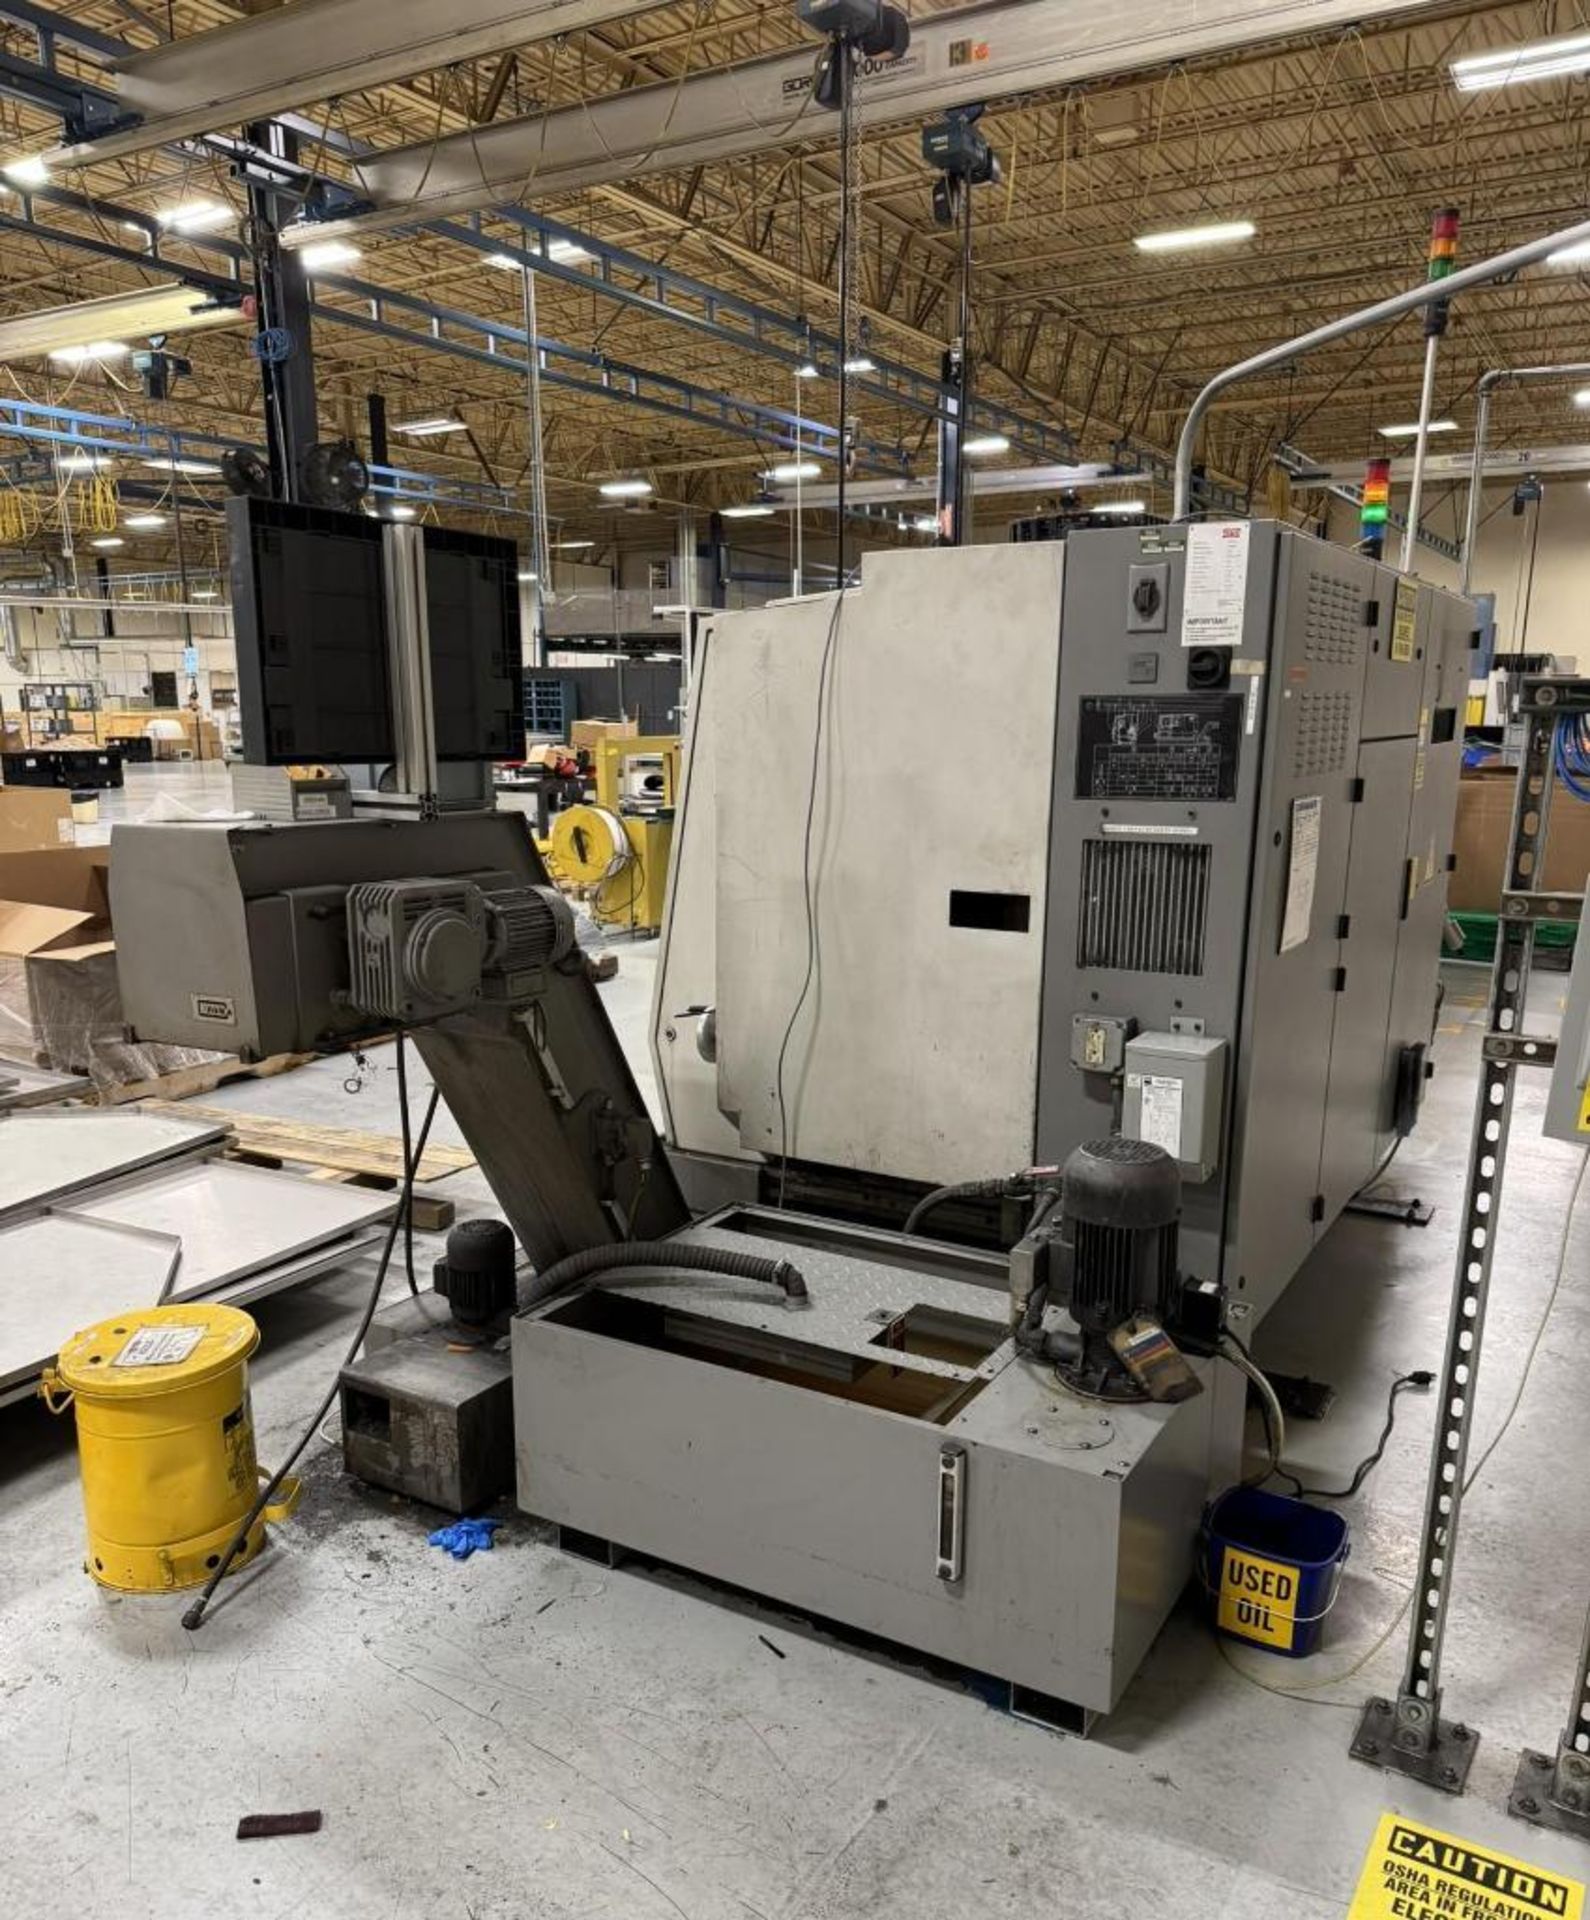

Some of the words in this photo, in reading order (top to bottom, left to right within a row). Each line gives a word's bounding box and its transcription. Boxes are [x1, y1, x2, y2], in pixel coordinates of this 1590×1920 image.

[782, 76, 813, 93] GOR
[1229, 1558, 1292, 1601] USED
[1237, 1597, 1275, 1633] OIL
[1383, 1860, 1430, 1887] OSHA
[1435, 1878, 1543, 1920] REGULATIO
[1393, 1830, 1566, 1911] CAUTION
[1384, 1877, 1430, 1905] AREA
[1436, 1896, 1457, 1913] IN
